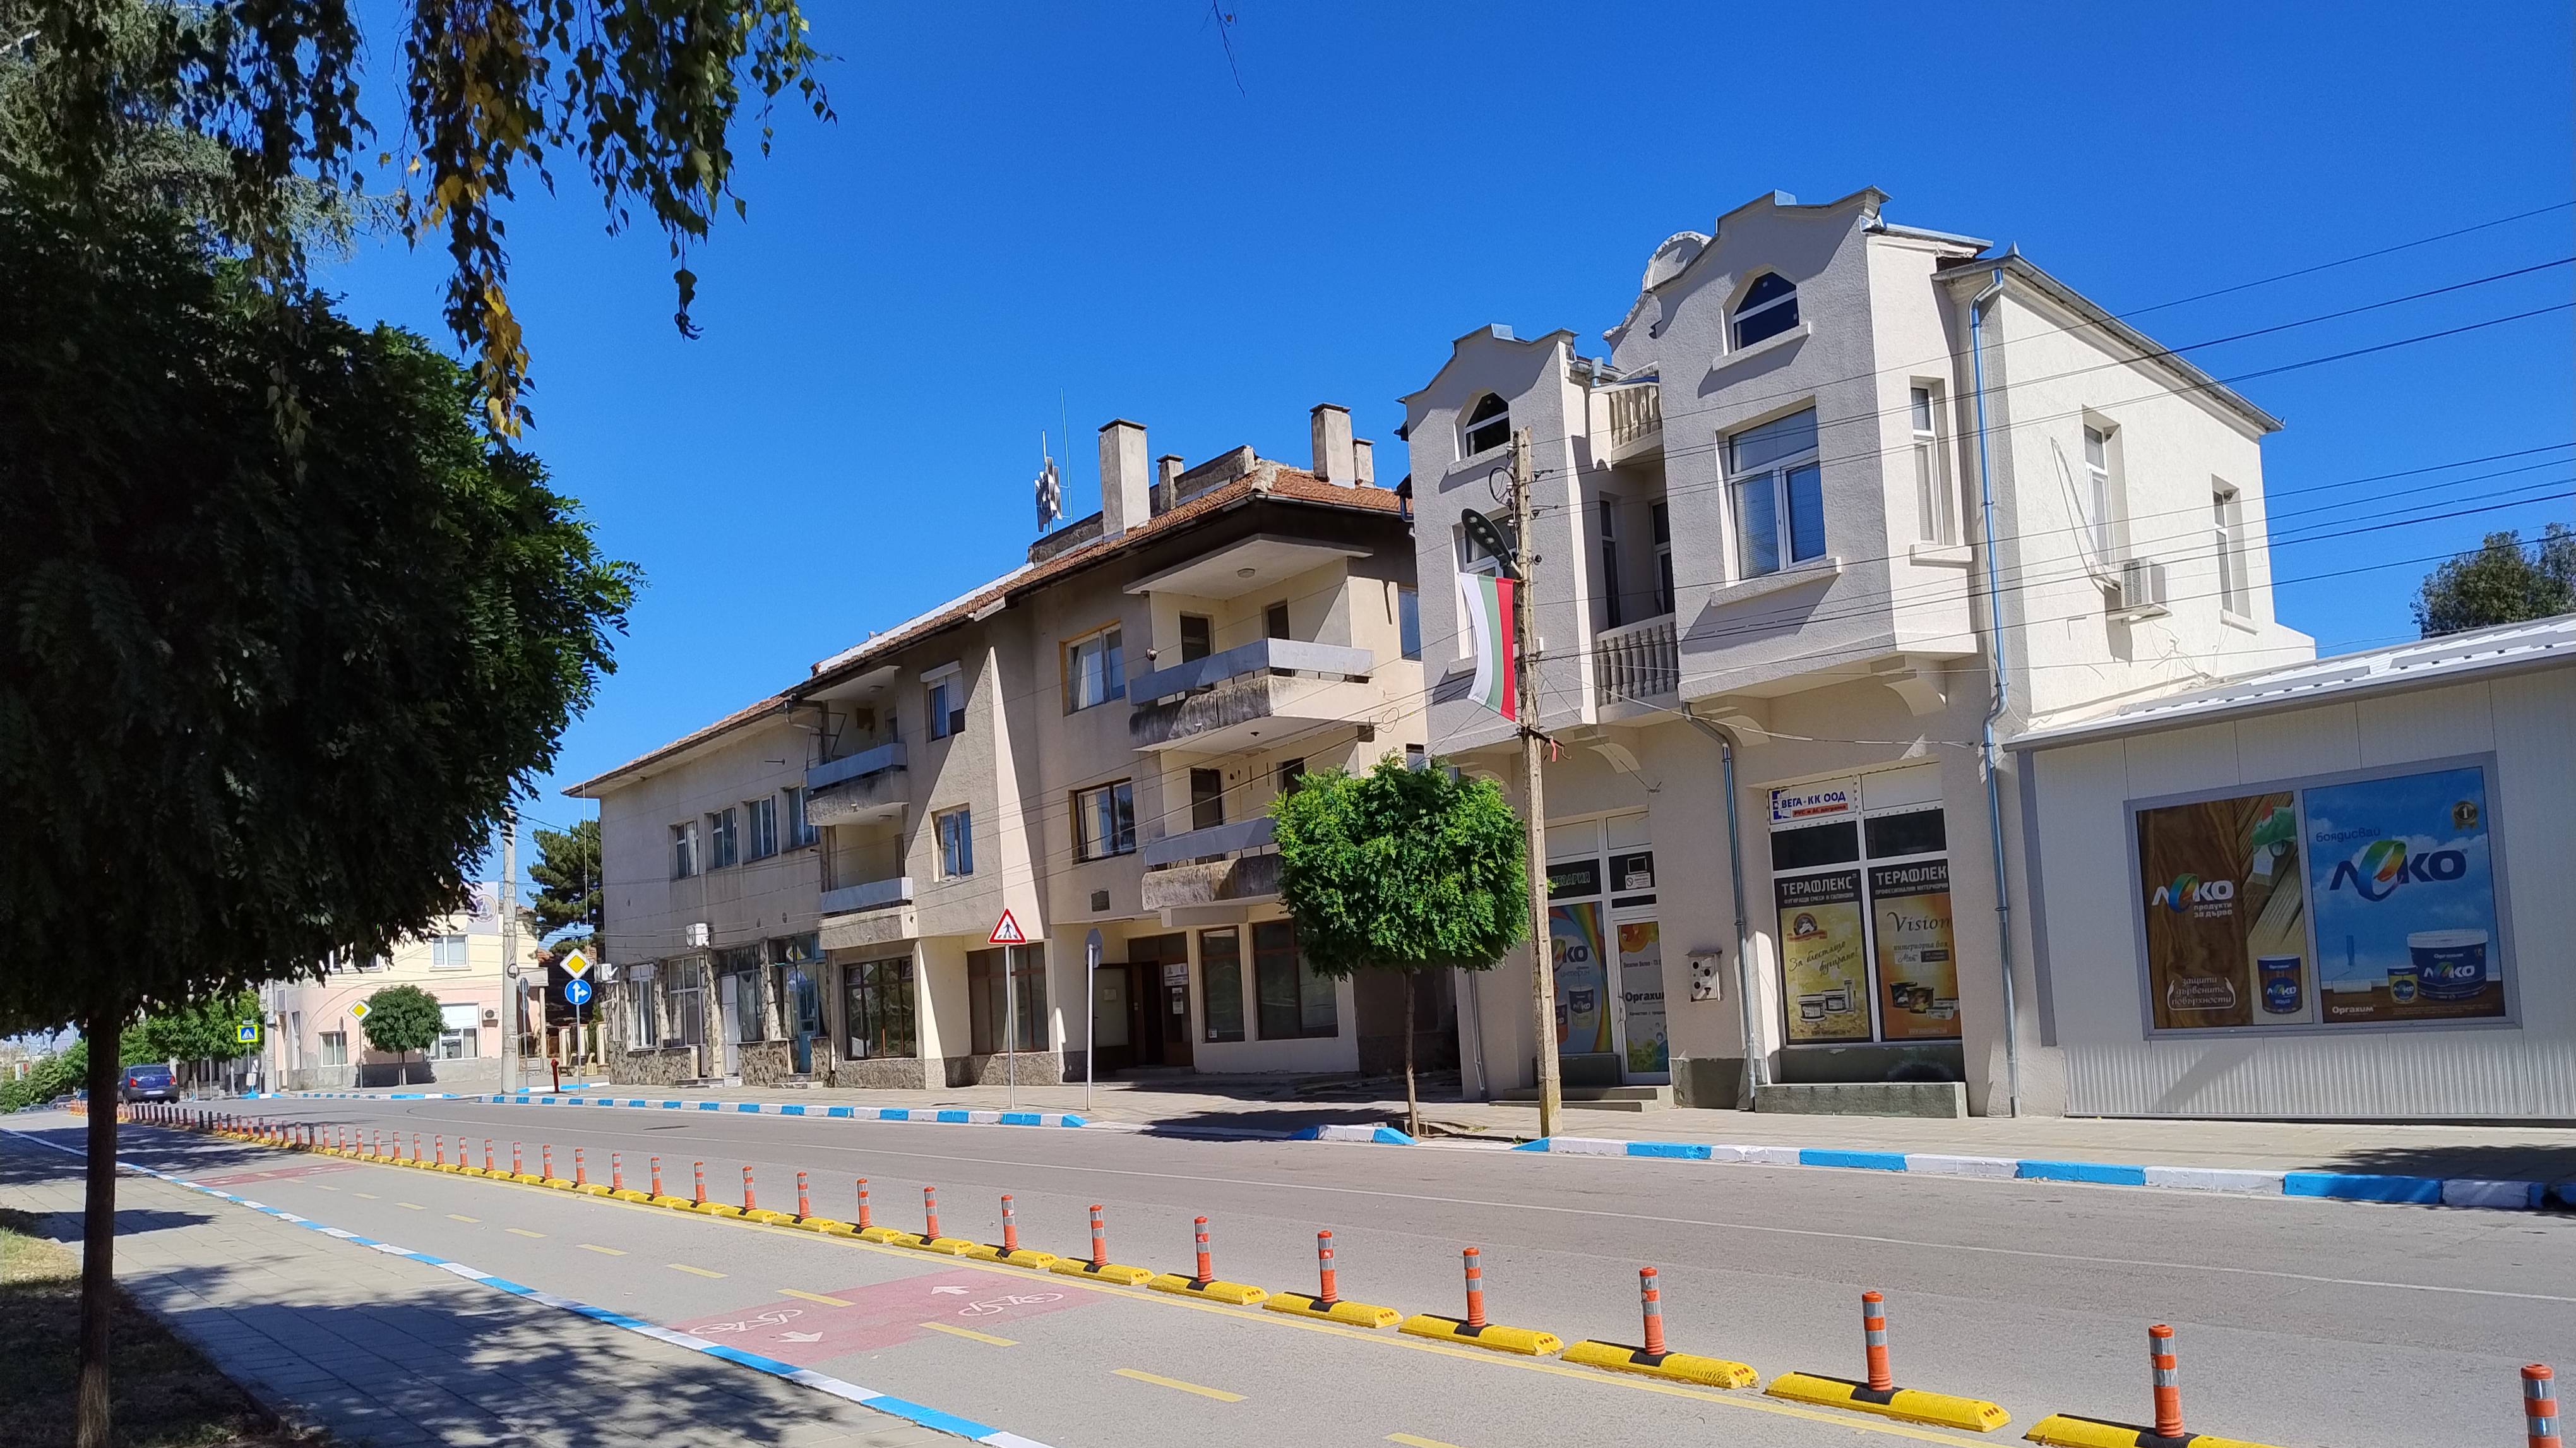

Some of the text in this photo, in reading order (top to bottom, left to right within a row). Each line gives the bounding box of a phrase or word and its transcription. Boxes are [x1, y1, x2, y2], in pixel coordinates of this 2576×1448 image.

[1823, 791, 1846, 803] ООД
[1875, 866, 1947, 885] ТЕРАФЛЕК
[1781, 877, 1853, 895] ТЕРАФЛЕКС
[2193, 902, 2233, 911] продукти
[2205, 909, 2233, 918] дърво
[1887, 911, 1950, 932] Vision
[1789, 957, 1803, 972] За
[2182, 977, 2217, 986] защити
[2176, 986, 2225, 996] дървените
[2172, 996, 2231, 1007] повърхности
[2332, 1005, 2374, 1015] Оргахим
